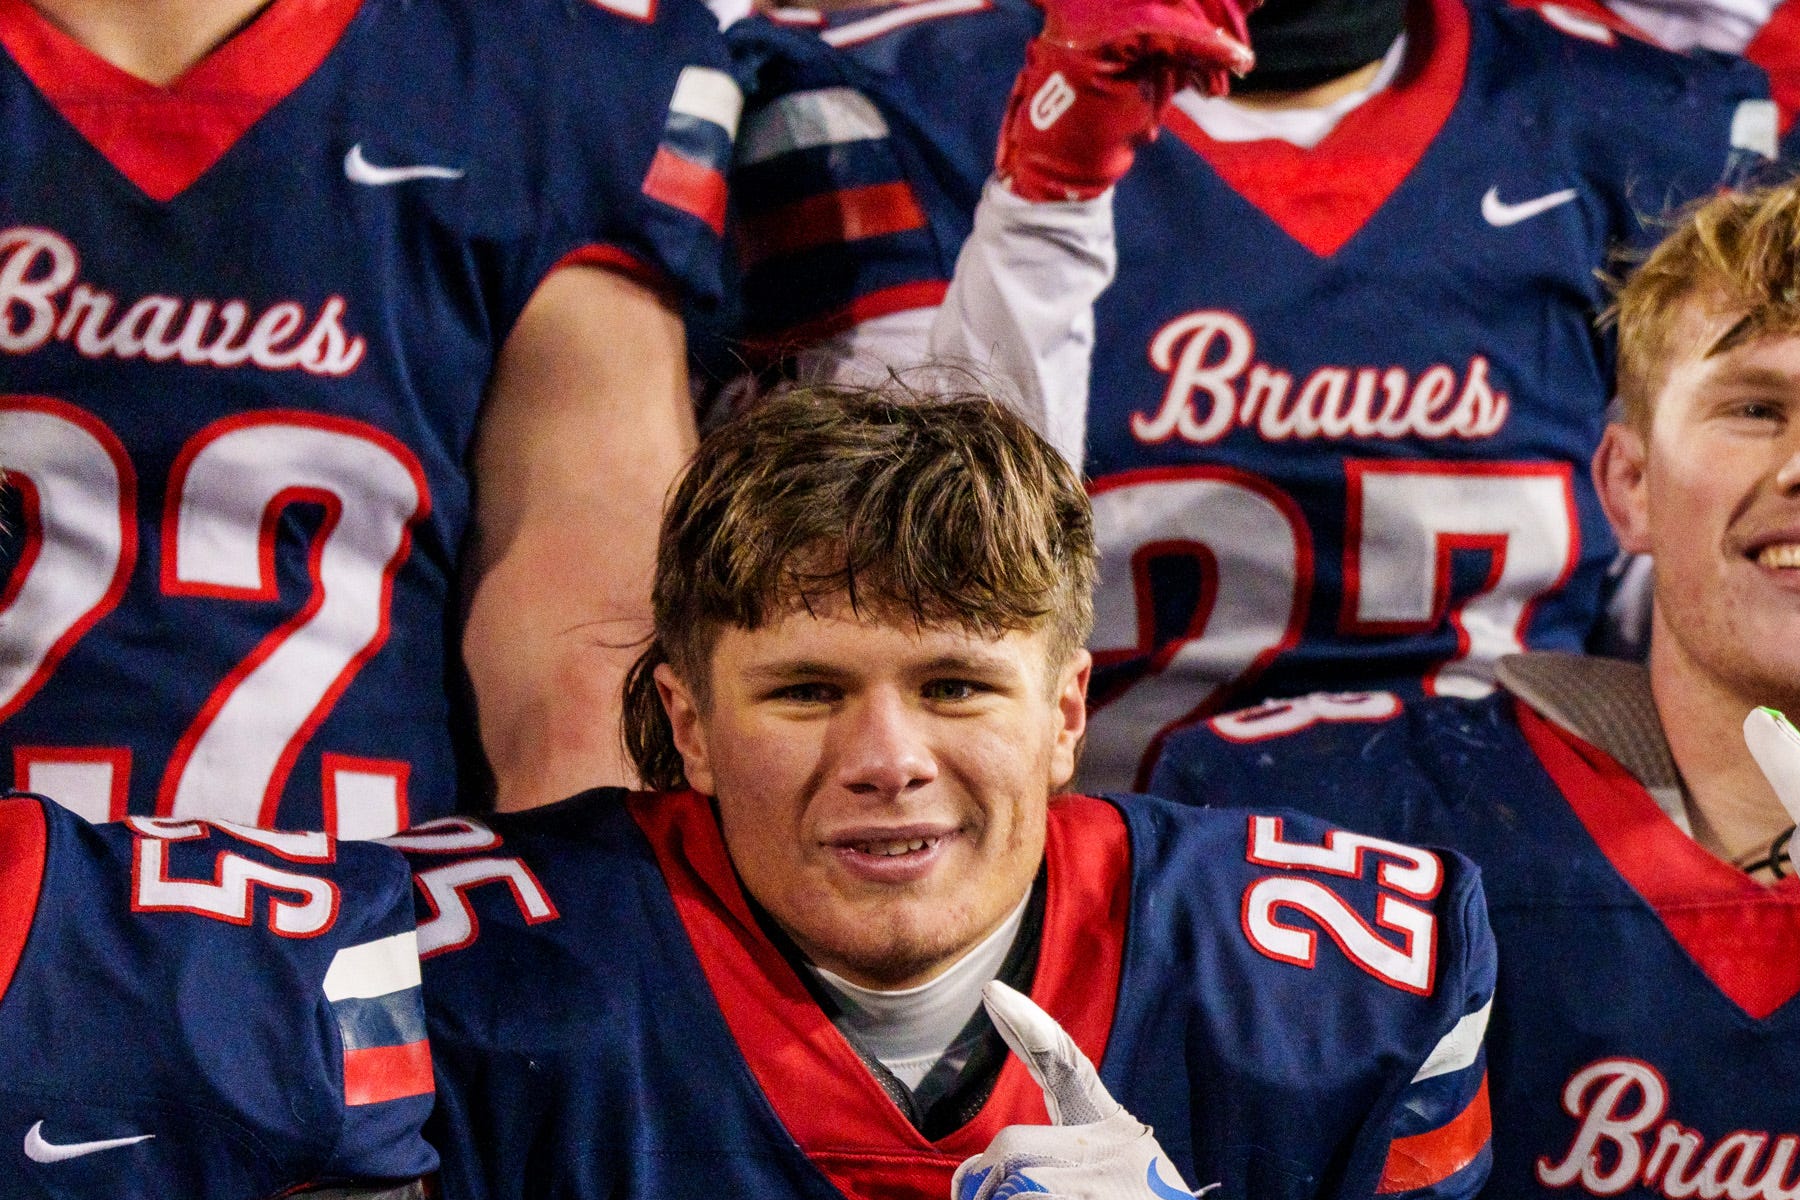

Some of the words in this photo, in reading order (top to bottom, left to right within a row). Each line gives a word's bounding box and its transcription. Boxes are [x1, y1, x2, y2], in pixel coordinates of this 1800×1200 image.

[0, 226, 367, 376] Braves
[1130, 309, 1509, 445] Braves
[1242, 814, 1447, 998] 25
